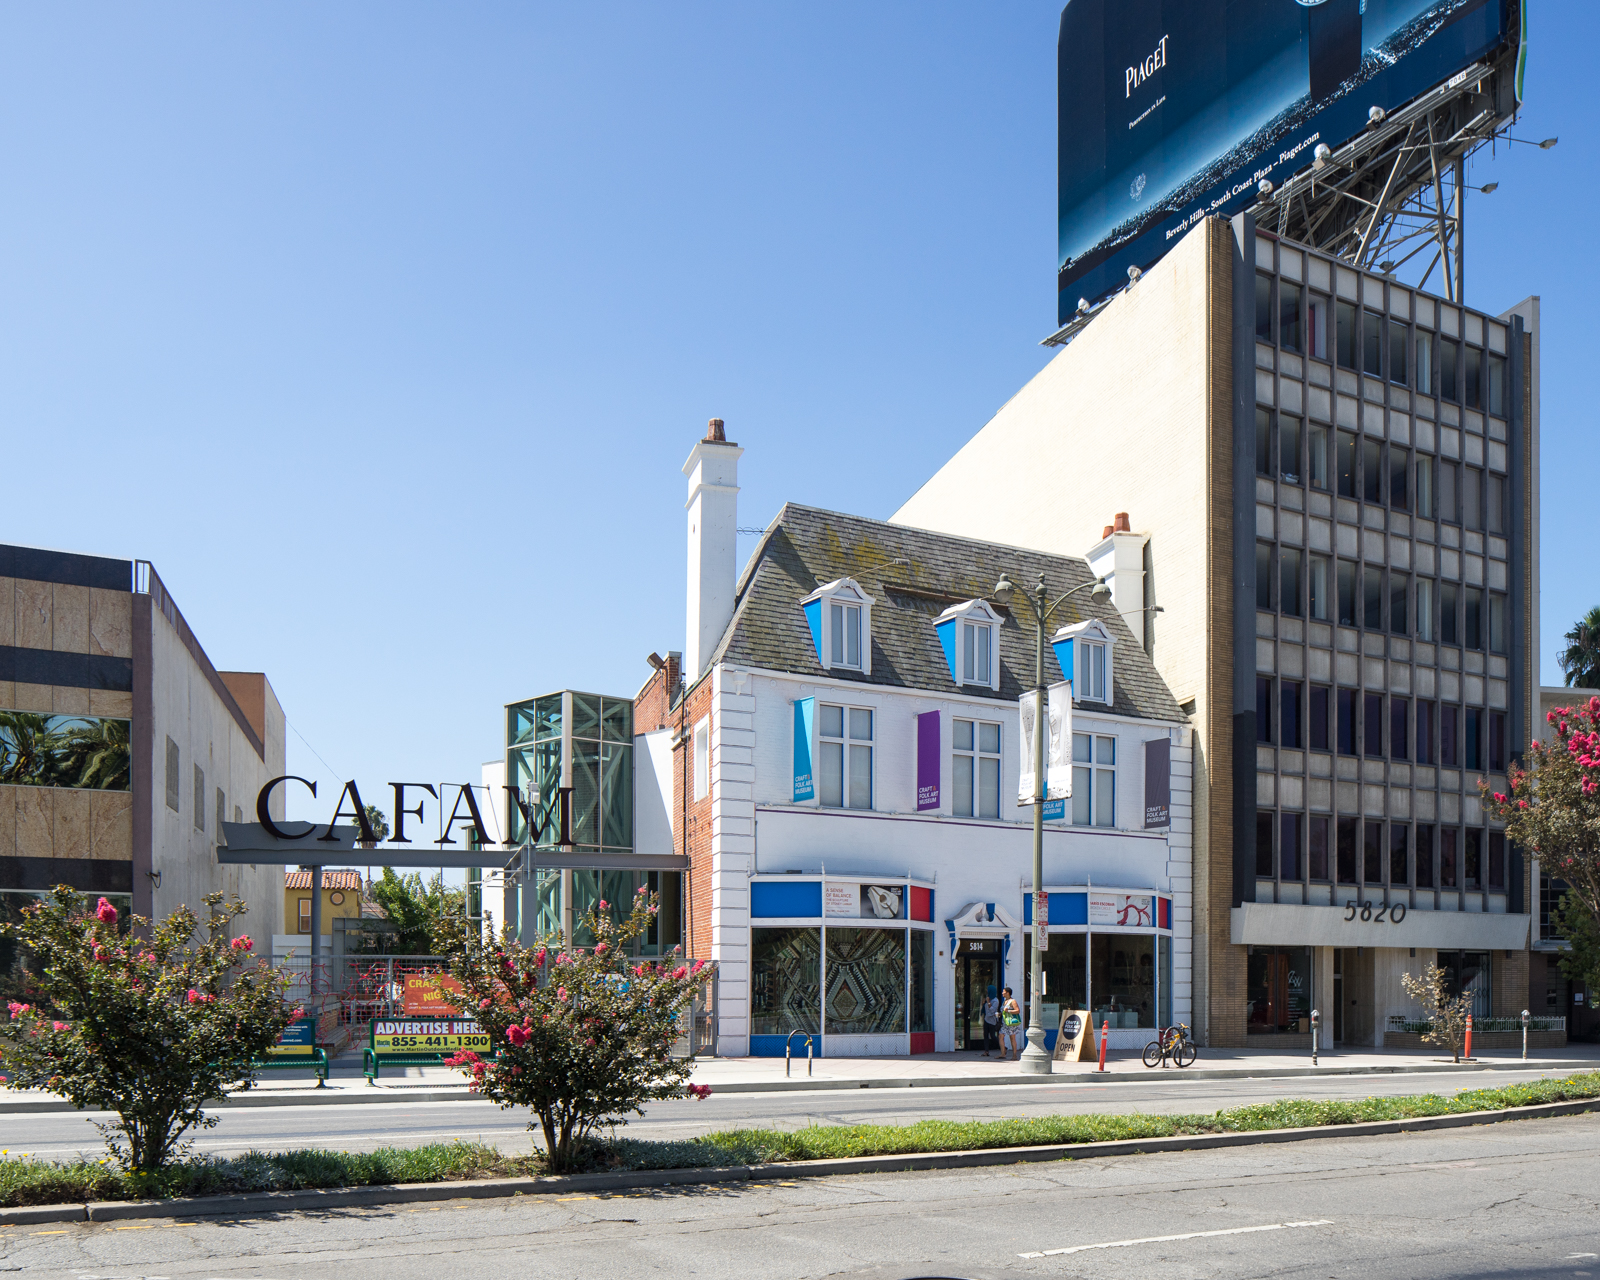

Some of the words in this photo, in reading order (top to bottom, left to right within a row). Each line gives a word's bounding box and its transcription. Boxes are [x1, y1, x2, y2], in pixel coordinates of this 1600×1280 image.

[1125, 33, 1169, 99] PIAGET
[1165, 218, 1189, 241] Beverly
[1189, 207, 1205, 225] Hills
[1210, 190, 1232, 211] South
[1232, 177, 1253, 196] Coast
[1253, 164, 1273, 183] Plaza
[1279, 131, 1320, 165] Piaget.com
[919, 785, 933, 793] CRAFT
[919, 797, 937, 805] MUSEUM
[1043, 802, 1055, 810] FOLK
[256, 775, 577, 846] CAFAM
[1146, 805, 1161, 813] CRAFT
[1344, 899, 1407, 924] 5820
[969, 942, 983, 951] 5814
[423, 987, 454, 1002] NIGT
[376, 1022, 449, 1035] ADVERTISE
[391, 1036, 488, 1047] 855-441-1300
[1060, 1042, 1076, 1053] OPEN
